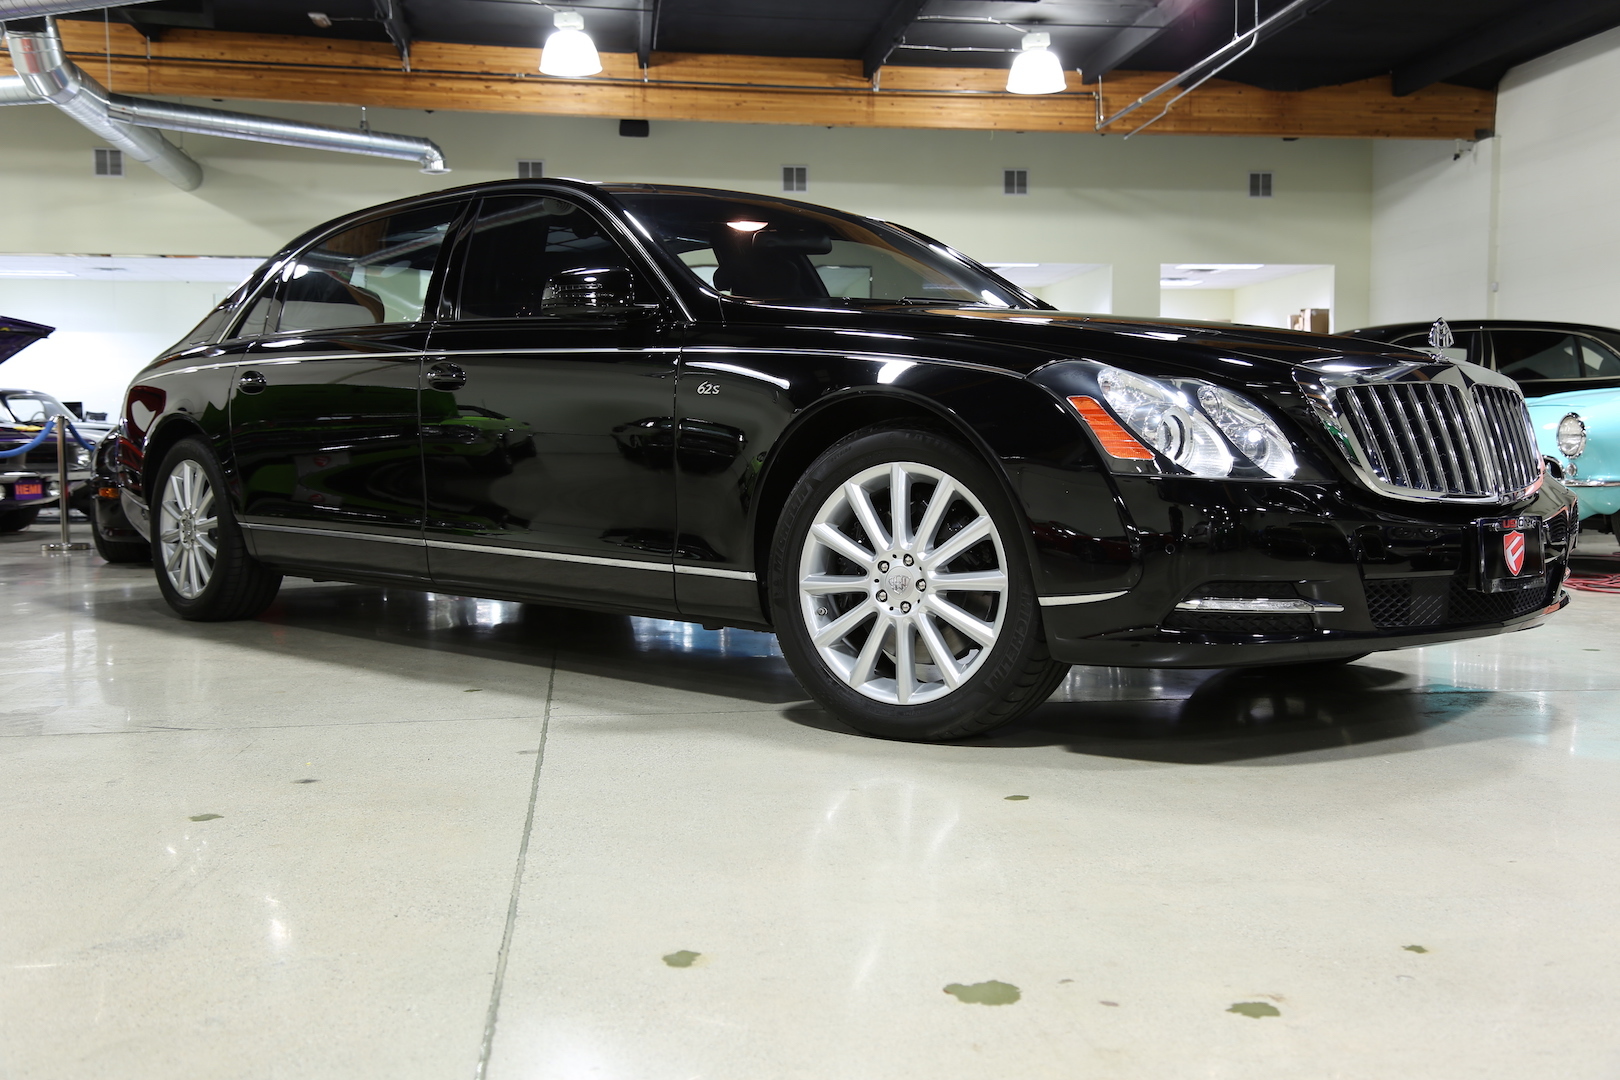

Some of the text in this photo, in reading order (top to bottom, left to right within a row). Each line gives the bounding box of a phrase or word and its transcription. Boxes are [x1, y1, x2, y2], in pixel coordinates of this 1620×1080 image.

[15, 484, 42, 494] HEMI
[773, 483, 811, 572] MICHELIN
[989, 591, 1033, 690] MICHELIN
